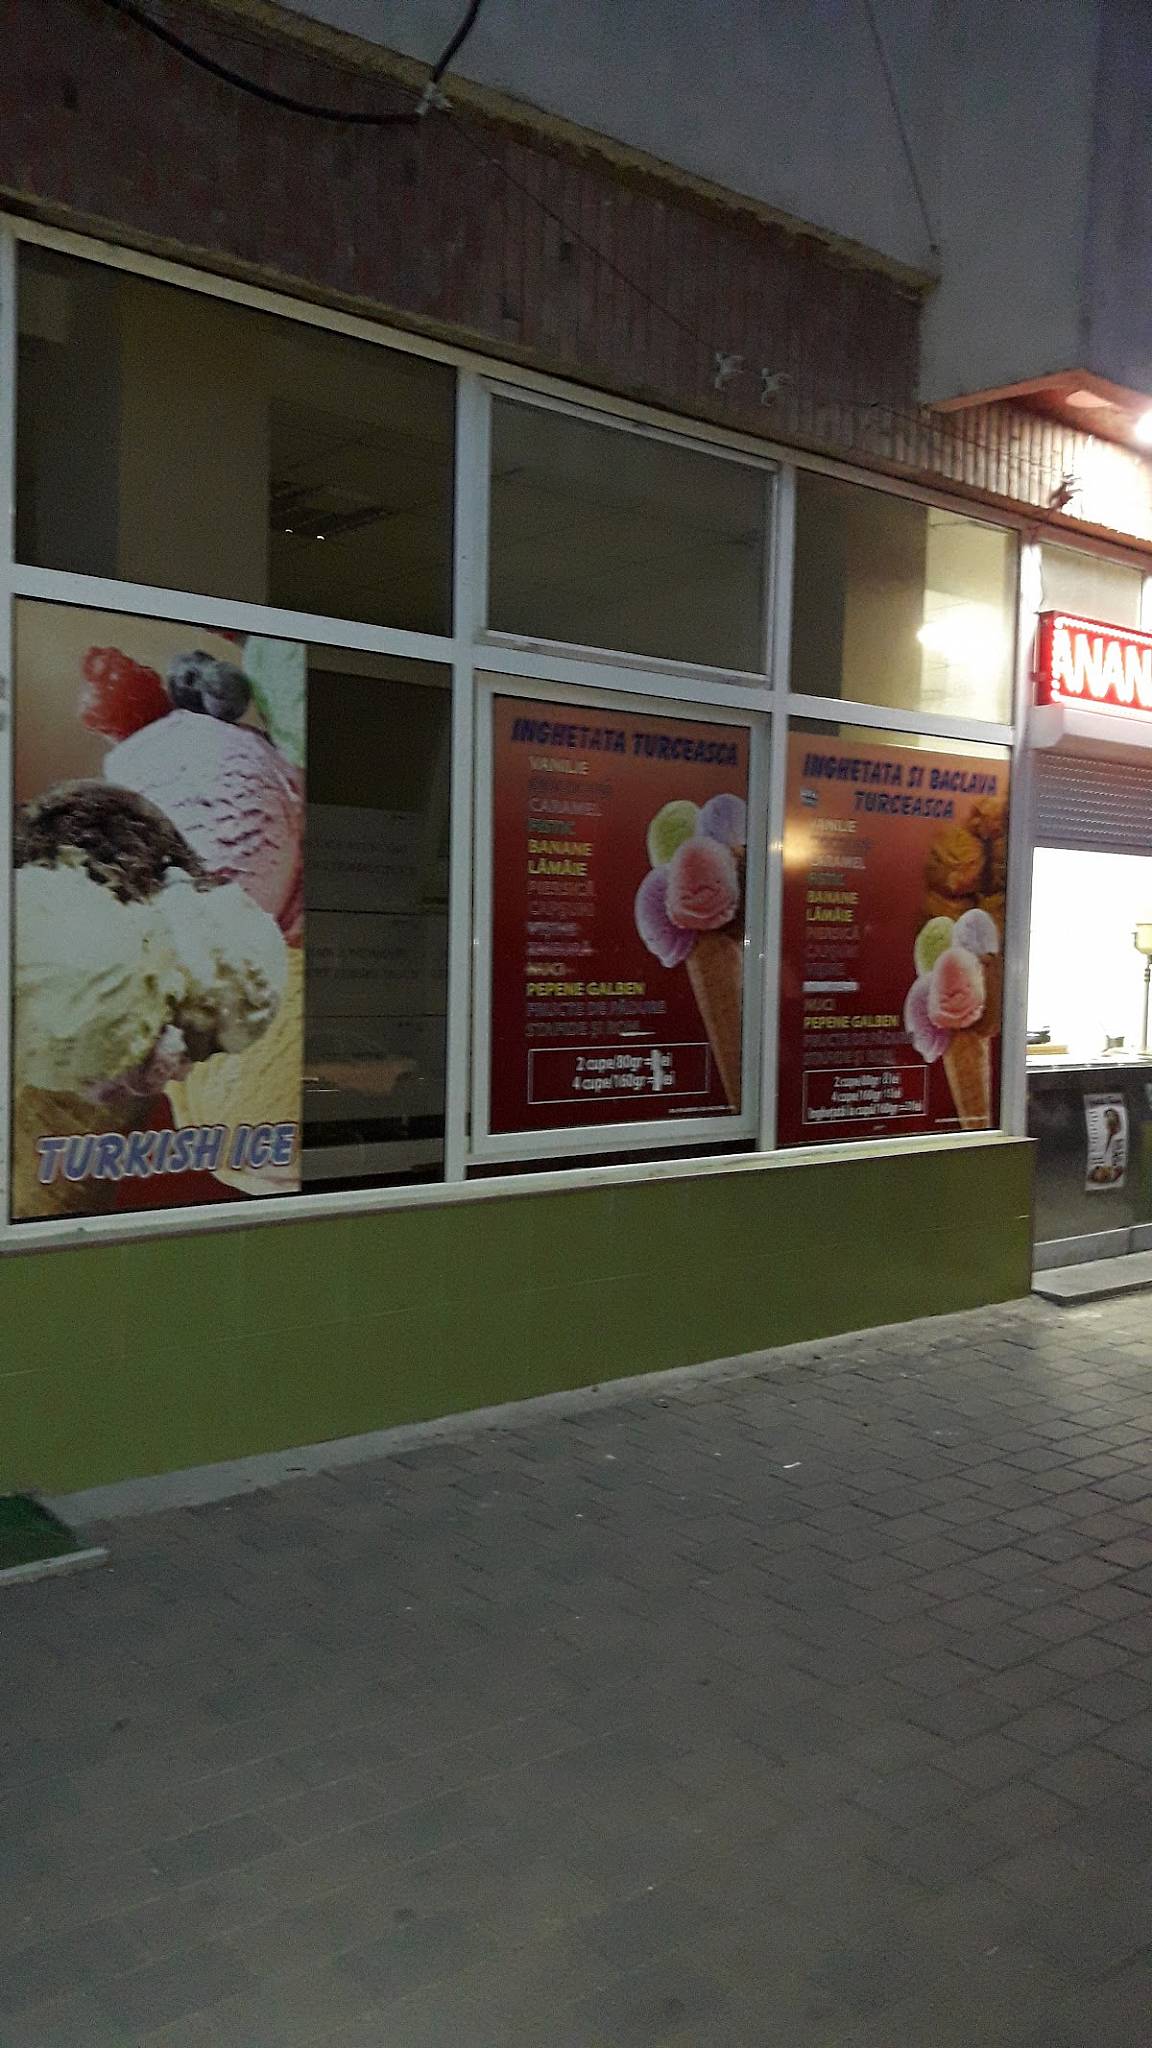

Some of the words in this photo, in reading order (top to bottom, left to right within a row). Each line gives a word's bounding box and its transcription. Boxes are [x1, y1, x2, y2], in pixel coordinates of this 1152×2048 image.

[511, 718, 626, 754] INGHETATA
[632, 733, 739, 766] TURCEASCA
[802, 753, 902, 787] INGHETATA
[907, 766, 924, 788] SI
[929, 768, 998, 796] BACLAVA
[853, 791, 955, 819] TURCEASCA
[528, 839, 593, 857] BANANE
[526, 982, 585, 997] PEPENE
[586, 981, 646, 997] GALBEN
[576, 1056, 586, 1071] 2
[572, 1076, 582, 1090] 4
[37, 1124, 227, 1185] TURKISH
[231, 1121, 298, 1170] ICE
